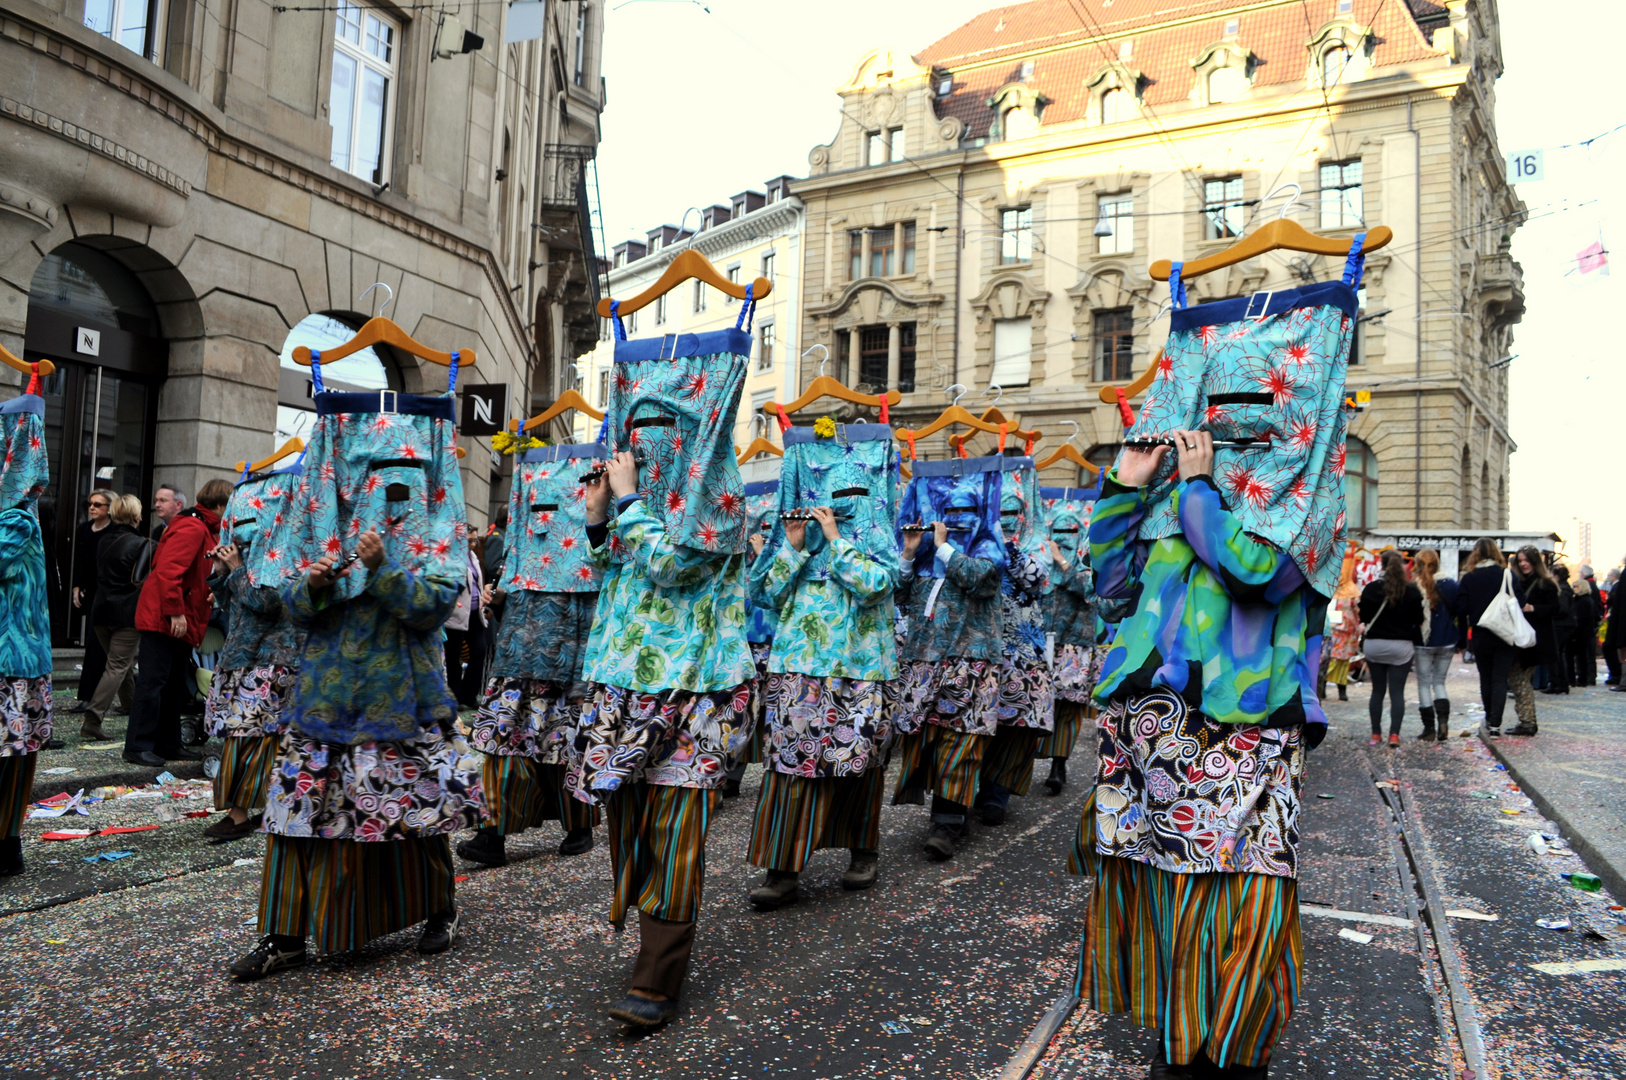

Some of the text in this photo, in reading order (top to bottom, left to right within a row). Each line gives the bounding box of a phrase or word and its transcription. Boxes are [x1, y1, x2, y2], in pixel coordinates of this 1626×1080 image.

[1514, 155, 1537, 177] 16
[82, 332, 95, 351] N
[469, 394, 497, 425] N
